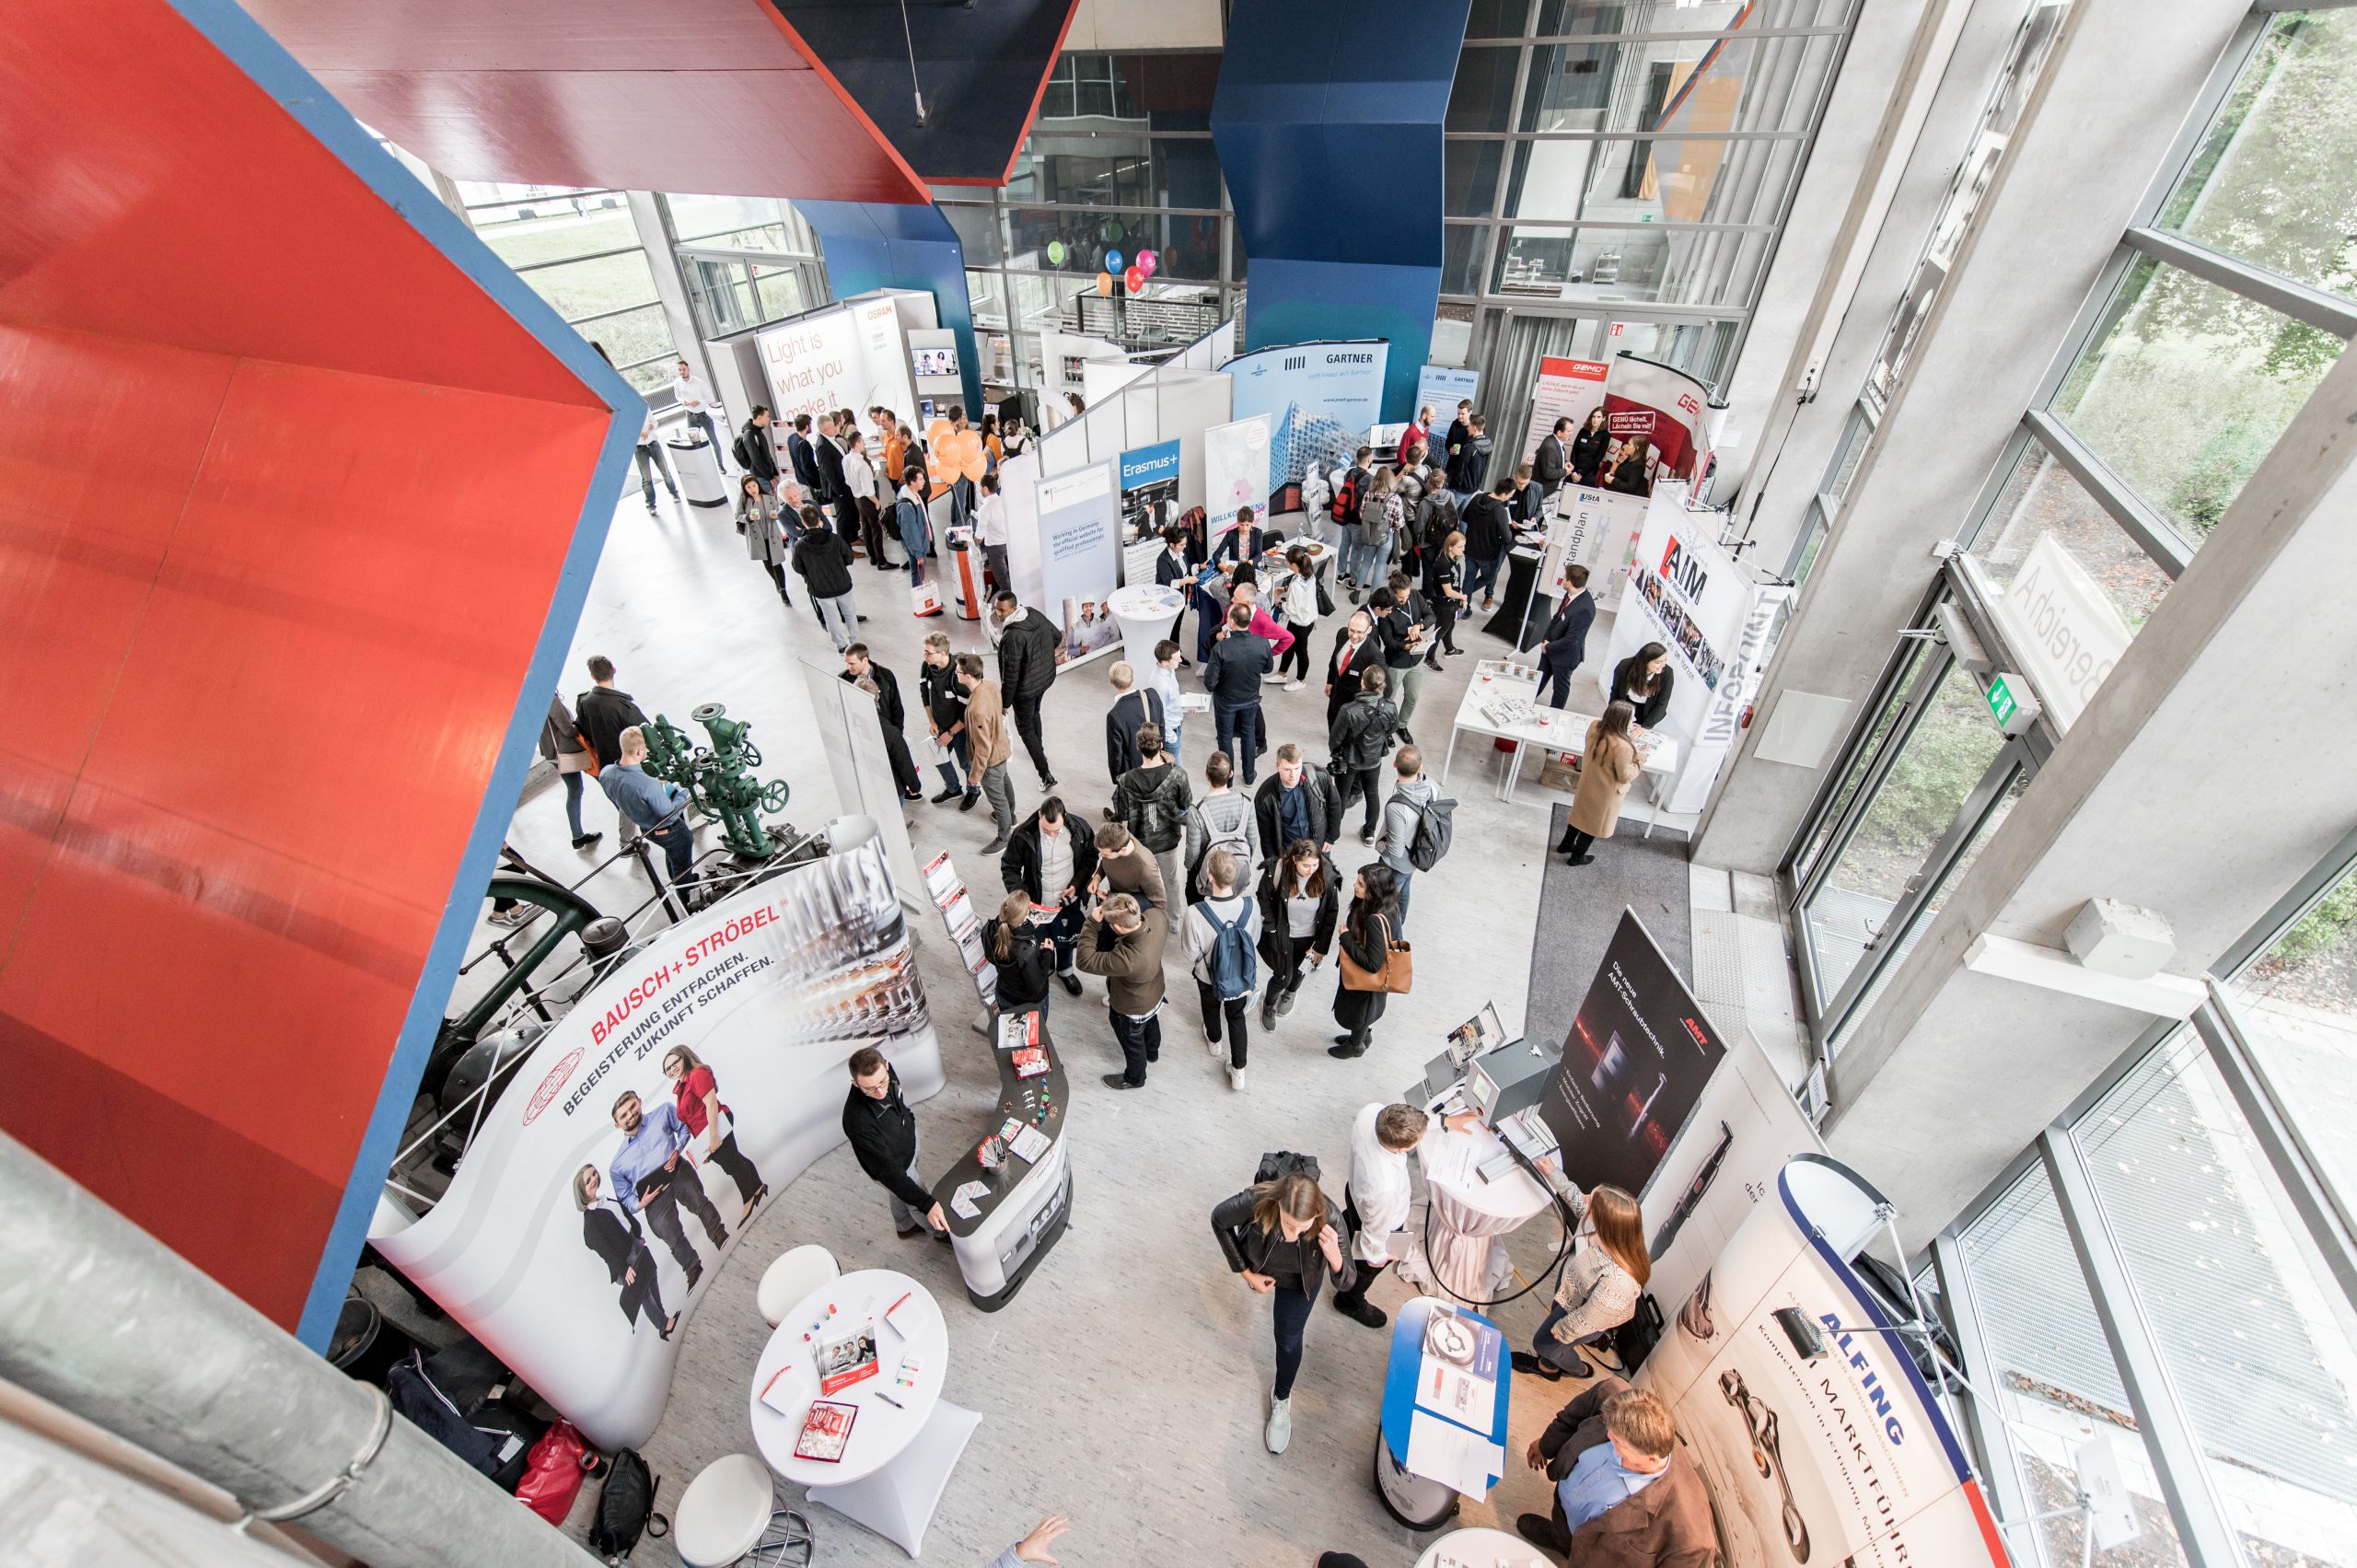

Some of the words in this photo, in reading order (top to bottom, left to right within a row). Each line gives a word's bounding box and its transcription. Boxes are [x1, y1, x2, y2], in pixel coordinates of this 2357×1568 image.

[867, 305, 892, 320] OSRAM
[767, 335, 807, 364] Light
[808, 331, 822, 350] is
[1326, 354, 1373, 364] GARTNER
[776, 366, 815, 394] what
[817, 359, 843, 385] you
[785, 398, 826, 421] make
[828, 390, 838, 408] it
[1123, 454, 1178, 477] Erasmus+
[1582, 494, 1600, 502] UStA
[1053, 530, 1074, 540] Working
[1054, 544, 1074, 556] qualified
[1563, 512, 1588, 567] Standplan
[1665, 542, 1708, 606] AIM
[1703, 591, 1782, 740] INFOPOINT
[590, 965, 671, 1046] BAUSCH
[672, 960, 683, 974] +
[684, 905, 780, 968] STRÖBEL
[1612, 960, 1622, 977] Die
[1622, 977, 1637, 998] neue
[634, 1003, 695, 1062] ZUKUNFT
[697, 956, 774, 1007] SCHAFFEN.
[1608, 972, 1665, 1059] AMT-Schraubtechnik.
[563, 1011, 661, 1117] BEGEISTERUNG
[661, 952, 749, 1014] ENTFACHEN.
[1685, 1017, 1708, 1045] AMT
[1575, 1099, 1588, 1121] Zugriff
[1580, 1094, 1600, 1128] Bedienung
[1745, 1183, 1759, 1203] der
[1759, 1324, 1816, 1409] Kompetenzen
[1817, 1413, 1825, 1427] in
[1819, 1312, 1904, 1446] ALFING
[1847, 1375, 1910, 1499] SONDERMASCHINEN
[1820, 1378, 1912, 1568] MARKTFÜHR
